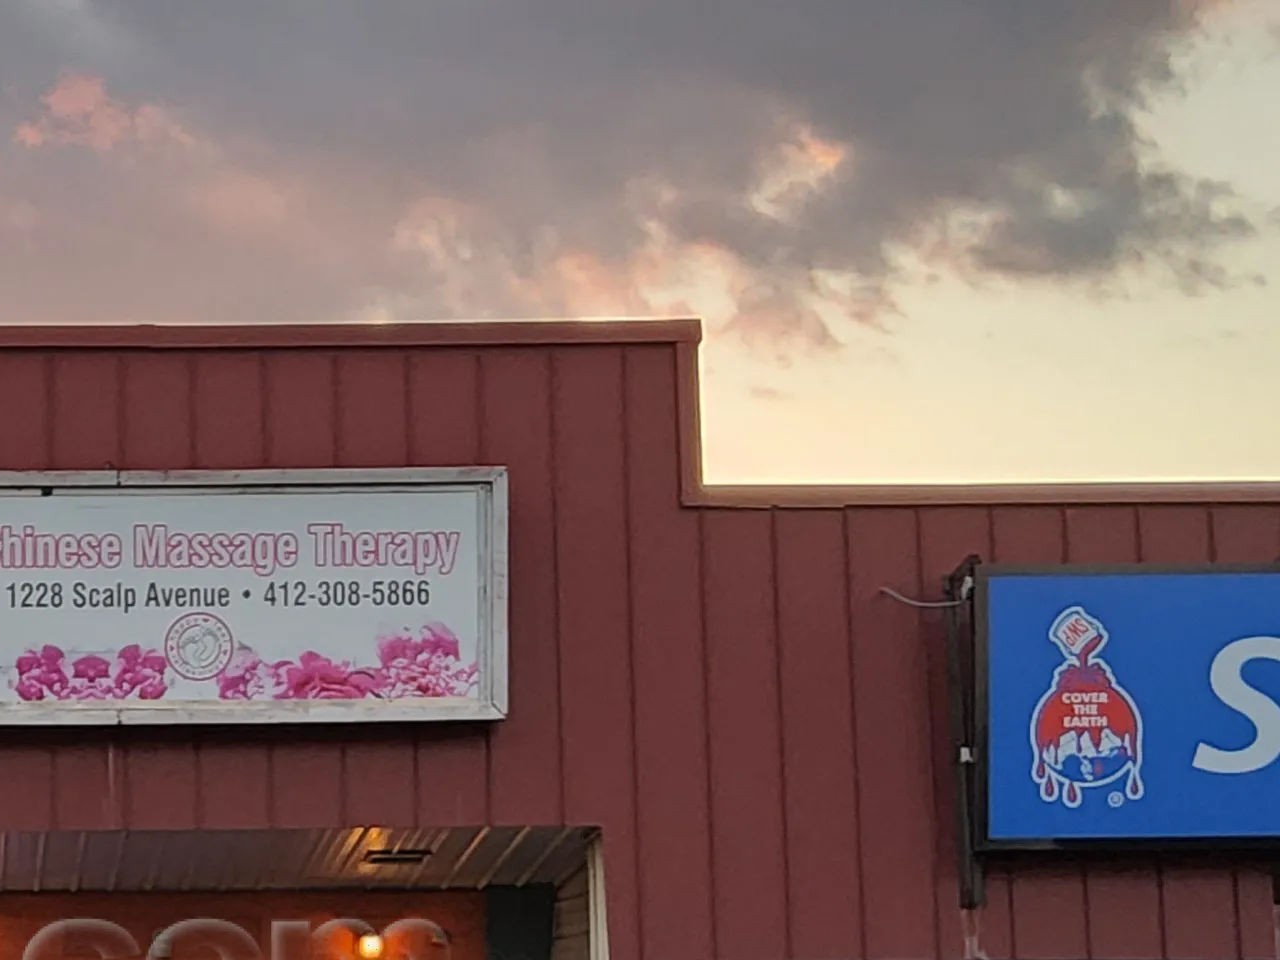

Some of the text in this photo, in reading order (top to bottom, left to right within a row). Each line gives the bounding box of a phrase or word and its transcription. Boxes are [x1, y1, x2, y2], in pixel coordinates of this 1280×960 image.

[133, 523, 298, 576] Massage
[307, 523, 460, 575] Therapy
[6, 580, 430, 613] 1228 Scalp Avenue 412-308-5866
[1062, 692, 1108, 704] COVER
[1073, 704, 1098, 715] THE
[1063, 716, 1108, 728] EARTH
